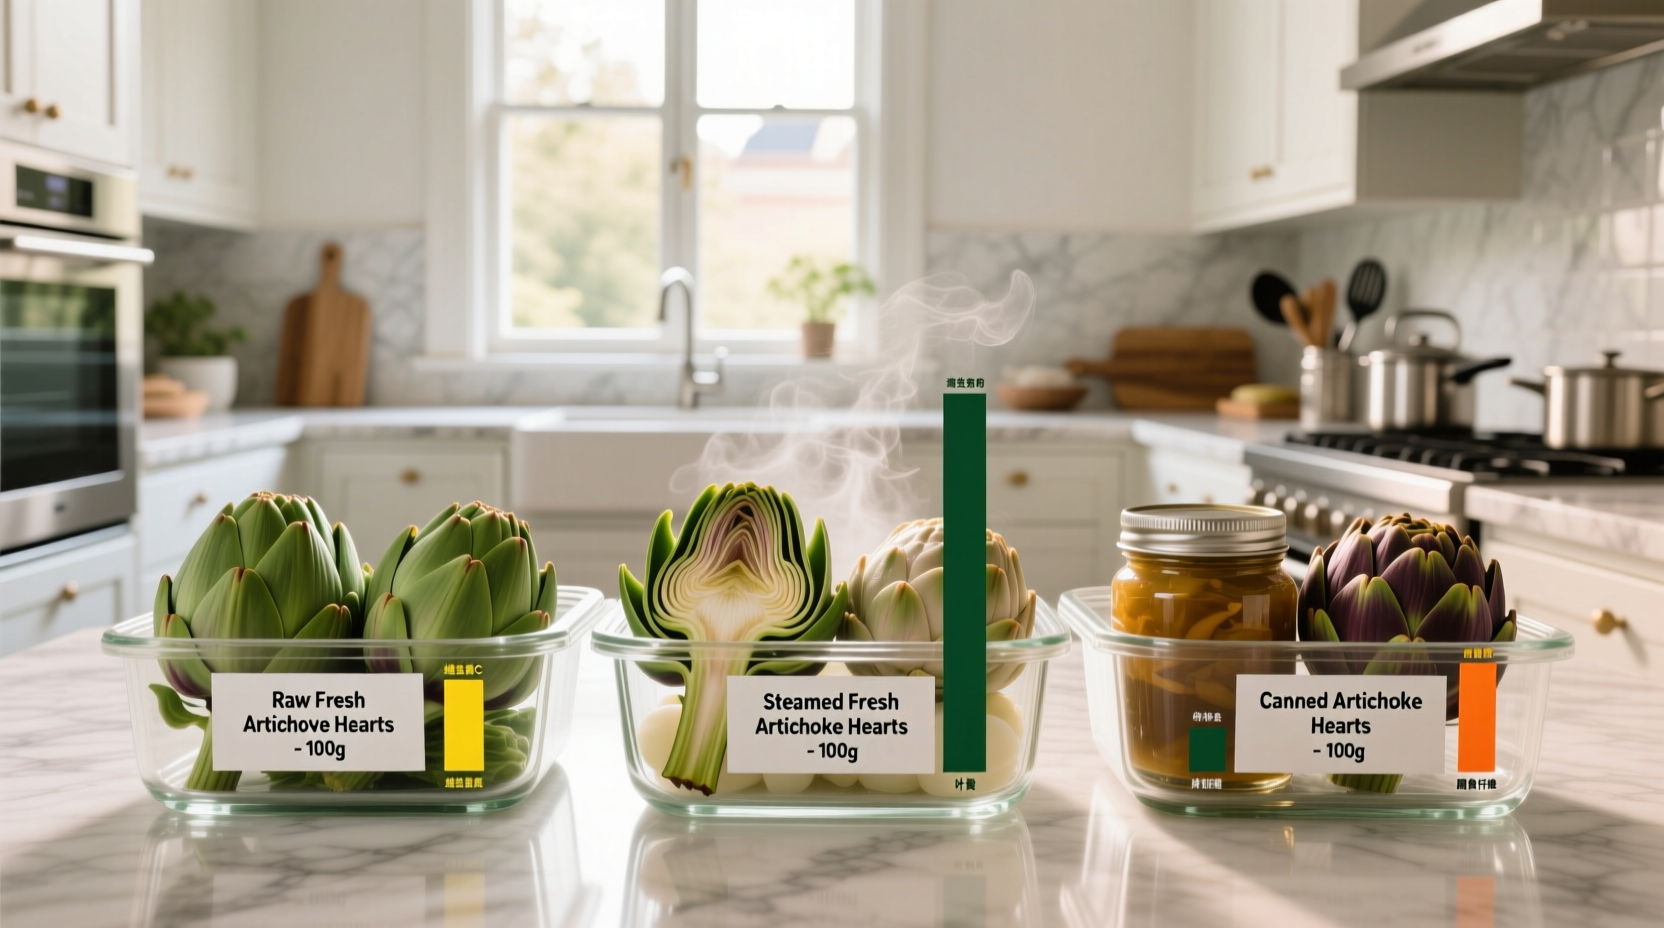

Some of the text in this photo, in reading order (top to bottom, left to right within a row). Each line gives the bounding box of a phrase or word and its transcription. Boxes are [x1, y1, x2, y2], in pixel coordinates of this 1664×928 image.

[272, 690, 366, 709] Raw Fresh
[763, 691, 899, 711] Steamed Fresh
[1259, 690, 1423, 710] Canned Artichoke
[242, 714, 395, 733] Artichove Hearts
[755, 716, 909, 736] Artichoke Hearts
[1311, 716, 1372, 735] Hearts
[305, 739, 346, 762] 100g
[818, 741, 858, 764] 100g
[1326, 741, 1366, 764] 100g
